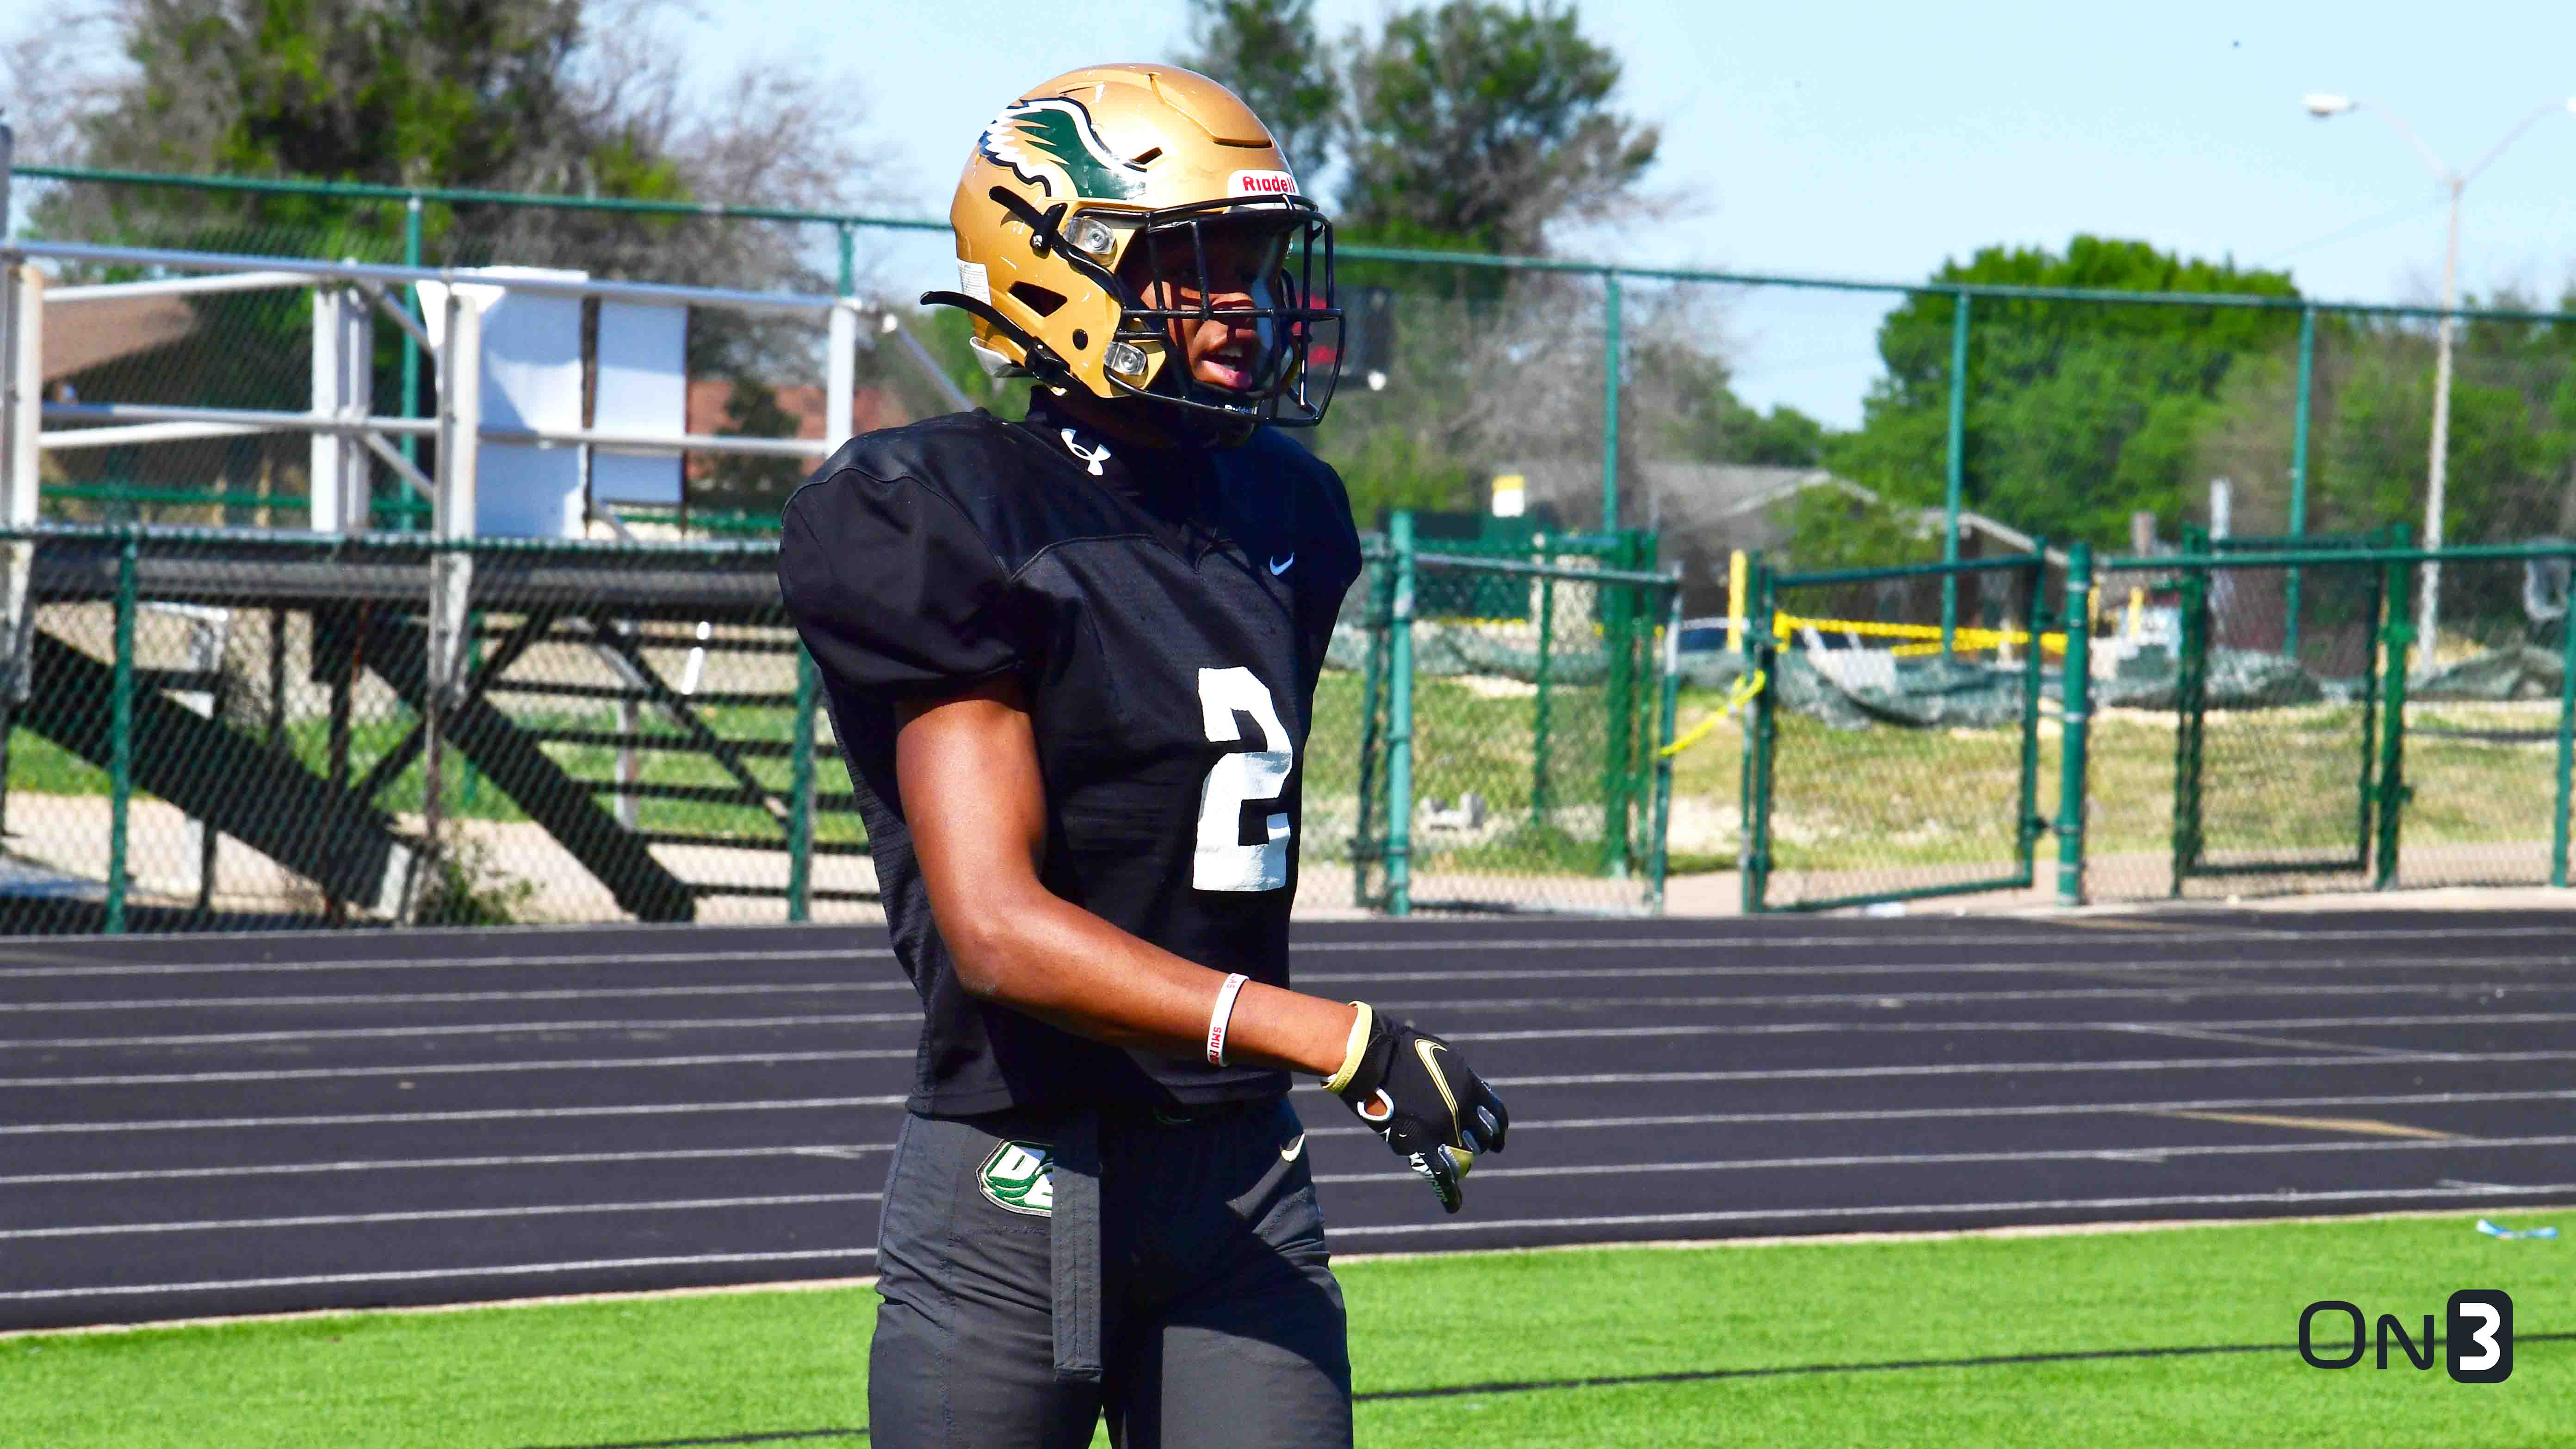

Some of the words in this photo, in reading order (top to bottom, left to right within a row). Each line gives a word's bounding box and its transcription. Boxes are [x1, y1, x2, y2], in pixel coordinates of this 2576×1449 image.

[1243, 175, 1296, 193] Riddell
[1193, 666, 1292, 892] 2
[1210, 1027, 1222, 1049] SMU
